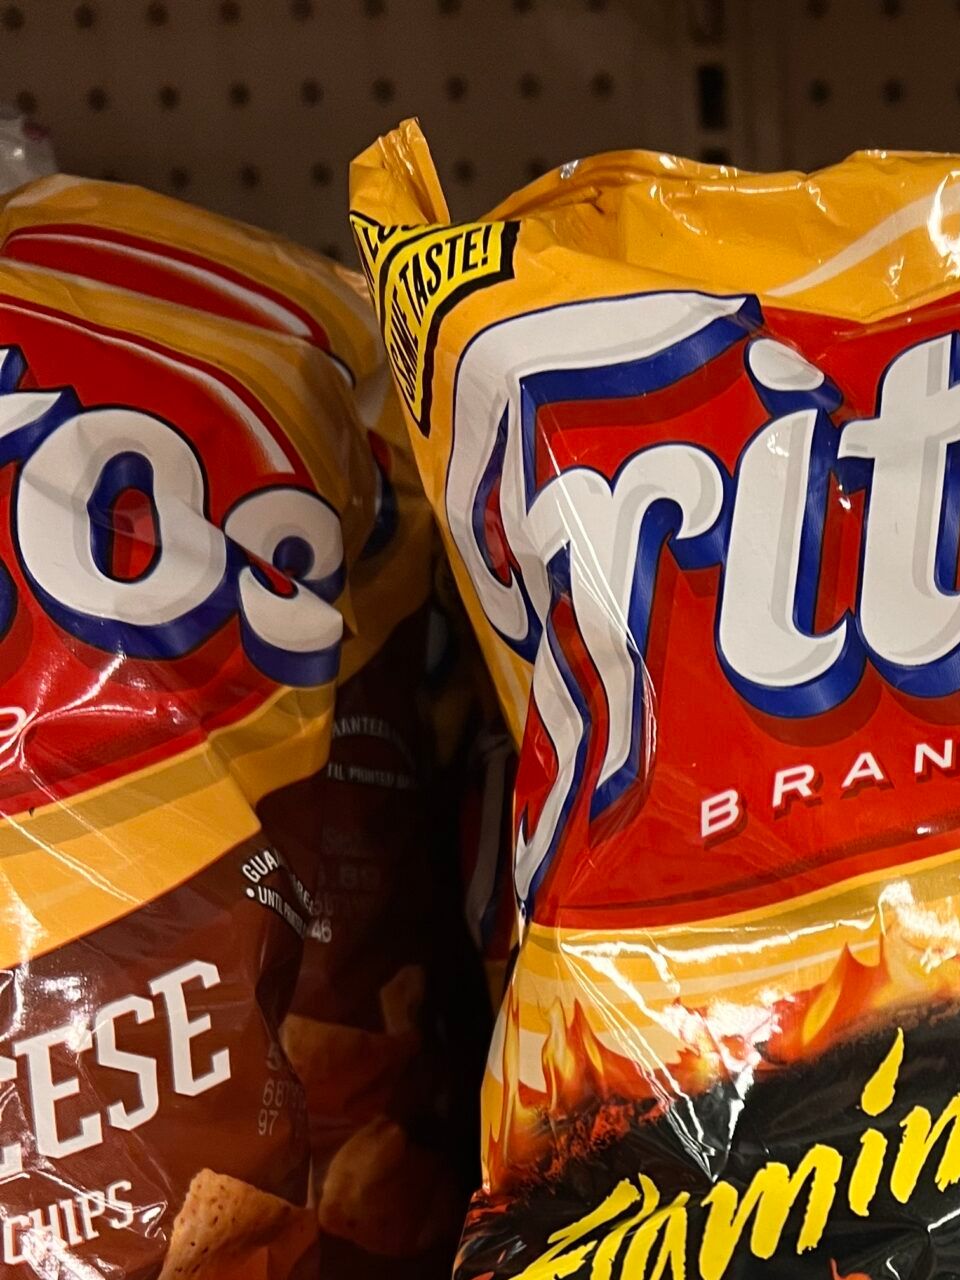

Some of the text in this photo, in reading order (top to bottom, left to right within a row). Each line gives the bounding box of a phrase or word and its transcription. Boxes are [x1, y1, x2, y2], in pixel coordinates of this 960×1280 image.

[399, 225, 492, 328] TASTE!
[0, 345, 346, 672] os
[0, 958, 231, 1183] ESE
[2, 1180, 134, 1265] CHIPS
